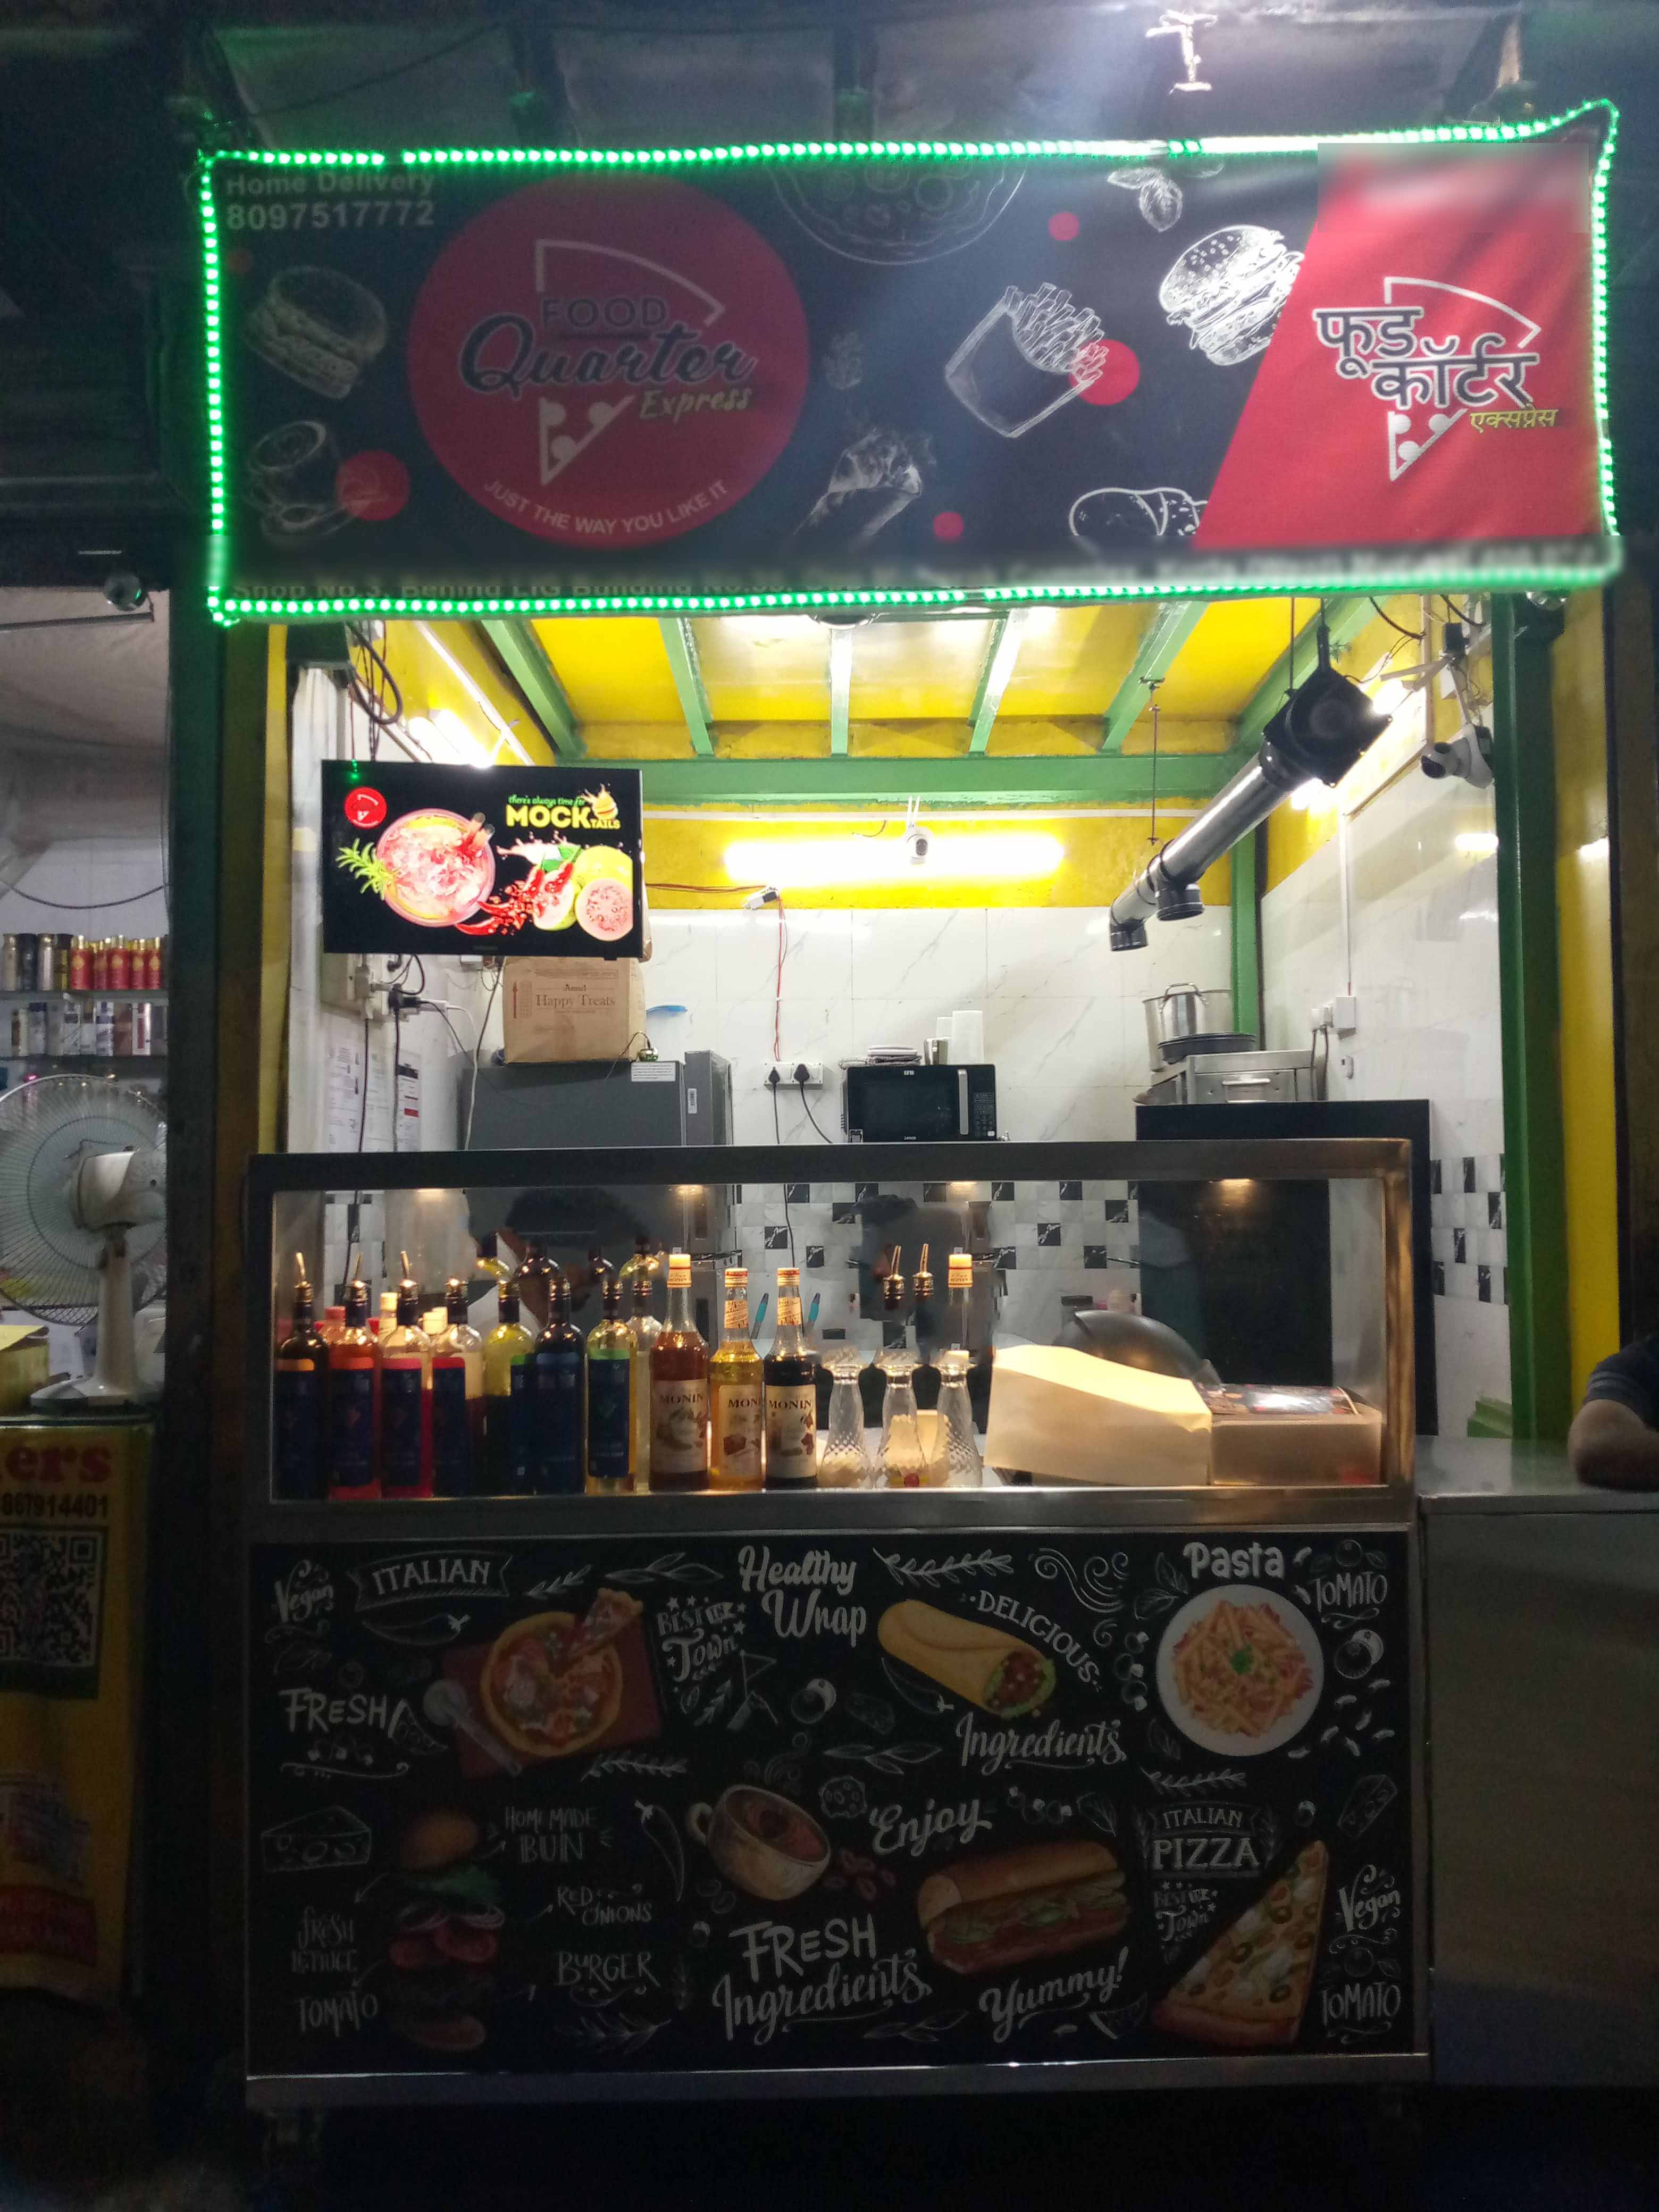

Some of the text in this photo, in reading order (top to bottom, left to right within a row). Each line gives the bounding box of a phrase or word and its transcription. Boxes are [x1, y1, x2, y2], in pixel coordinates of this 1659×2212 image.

[227, 170, 433, 196] Home Delivery
[227, 199, 435, 230] 8097517772
[541, 297, 671, 329] FOOD
[458, 312, 758, 400] Quarter
[1313, 306, 1425, 379] फूड
[639, 388, 753, 424] Express
[484, 480, 729, 534] JUST THE WAY YOU LIKE IT
[535, 994, 616, 1008] Happy Treats
[659, 1394, 703, 1404] MONIN
[769, 1400, 811, 1409] MONIN
[372, 1559, 490, 1595] ITALIAN
[738, 1545, 857, 1595] Healthy
[1183, 1541, 1285, 1579] Pasta
[274, 1560, 335, 1623] Vegan
[1311, 1571, 1388, 1612] TOMATO
[761, 1588, 867, 1647] Wrap
[978, 1590, 1100, 1682] DELICIOUS
[278, 1687, 388, 1733] FRESH
[956, 1711, 1127, 1775] Ingredients
[869, 1799, 993, 1856] Enjoy
[1162, 1808, 1243, 1829] ITALIAN
[519, 1833, 584, 1863] BUN
[1153, 1837, 1260, 1871] PIZZA
[1338, 1864, 1401, 1932] Vegan
[729, 1914, 877, 1983] FRESH
[554, 1951, 661, 1992] BURGER
[295, 1991, 379, 2038] TOMATO
[712, 1948, 933, 2046] Ingredients
[978, 1947, 1129, 2043] Yummy!
[1321, 1982, 1402, 2026] TOMATO
